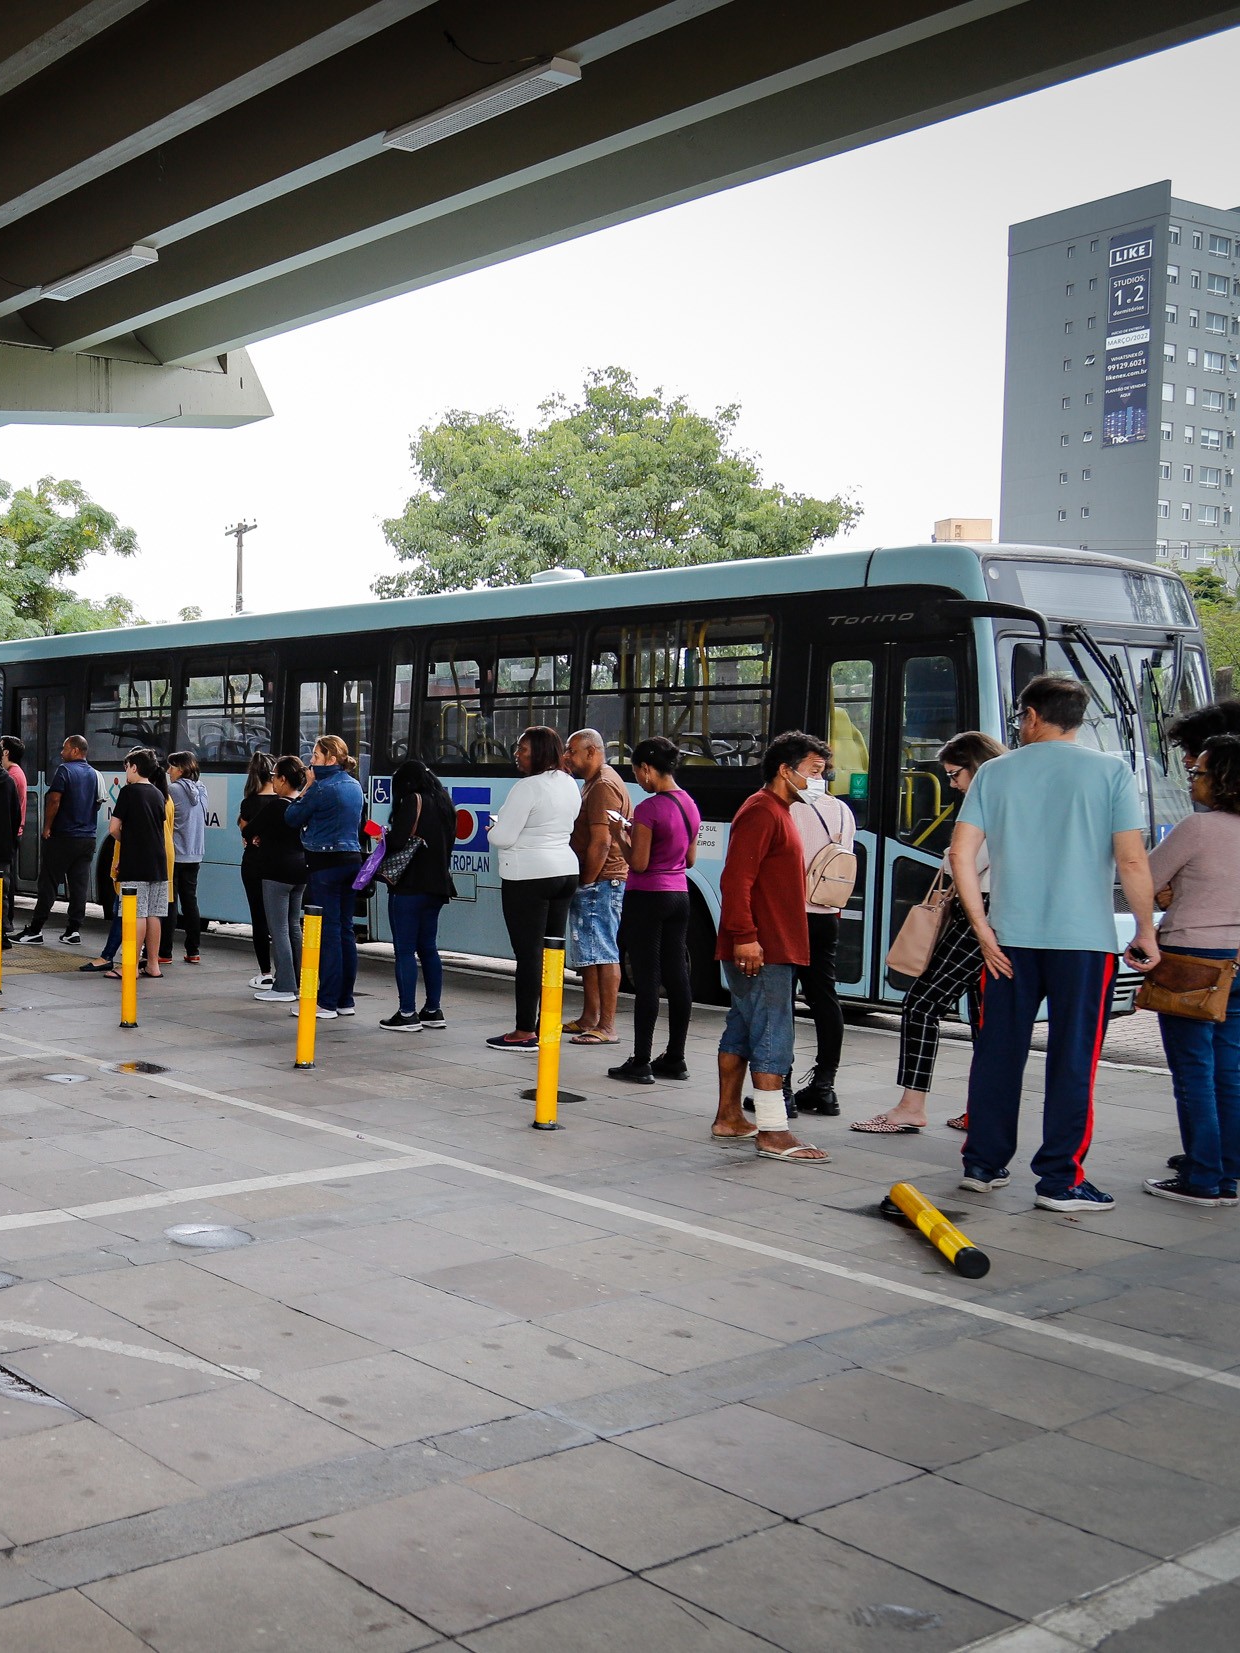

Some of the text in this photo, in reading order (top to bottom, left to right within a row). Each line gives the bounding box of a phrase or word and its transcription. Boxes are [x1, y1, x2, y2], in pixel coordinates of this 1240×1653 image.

[1115, 244, 1146, 262] LIKE
[1113, 274, 1146, 288] STUDIOS,
[1114, 289, 1122, 306] 1
[1133, 284, 1144, 302] 2
[1107, 332, 1148, 346] MARÇO/2022
[1107, 358, 1146, 372] 99129.6021
[1105, 368, 1147, 381] likenex.com.br
[828, 612, 915, 626] Torino
